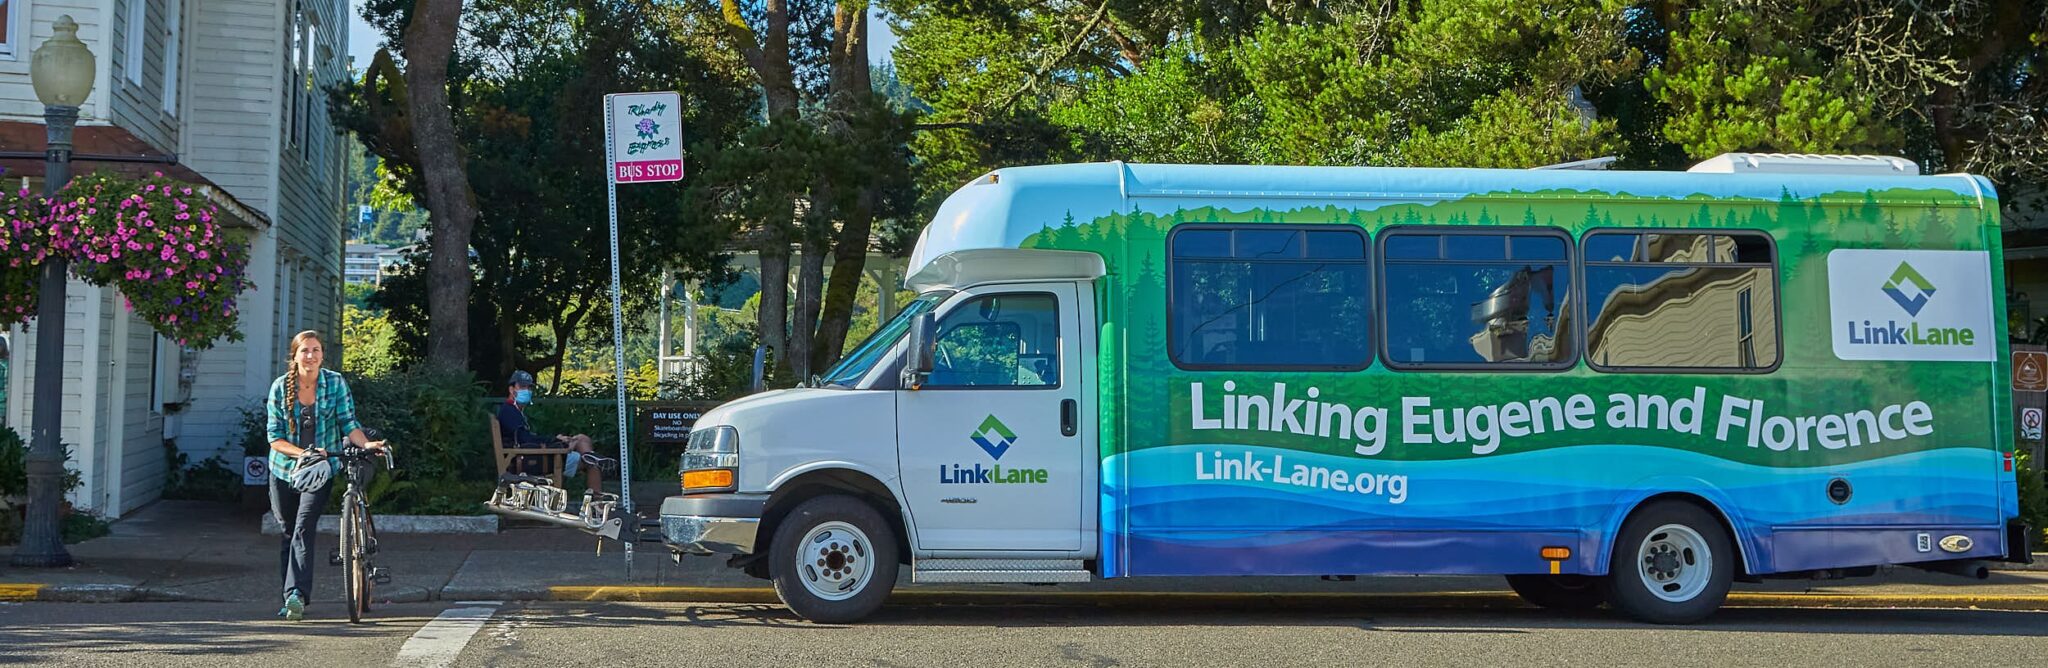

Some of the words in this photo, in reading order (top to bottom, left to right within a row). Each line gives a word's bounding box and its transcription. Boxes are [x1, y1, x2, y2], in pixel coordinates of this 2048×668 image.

[628, 101, 666, 116] Rhody
[627, 137, 669, 155] Express
[620, 165, 642, 178] BUS
[647, 163, 678, 177] STOP
[1191, 381, 1388, 456] Linking
[1402, 394, 1595, 455] Eugene
[1606, 386, 1706, 434] and
[1715, 394, 1934, 451] Florence
[1195, 450, 1408, 504] Link-Lane.org
